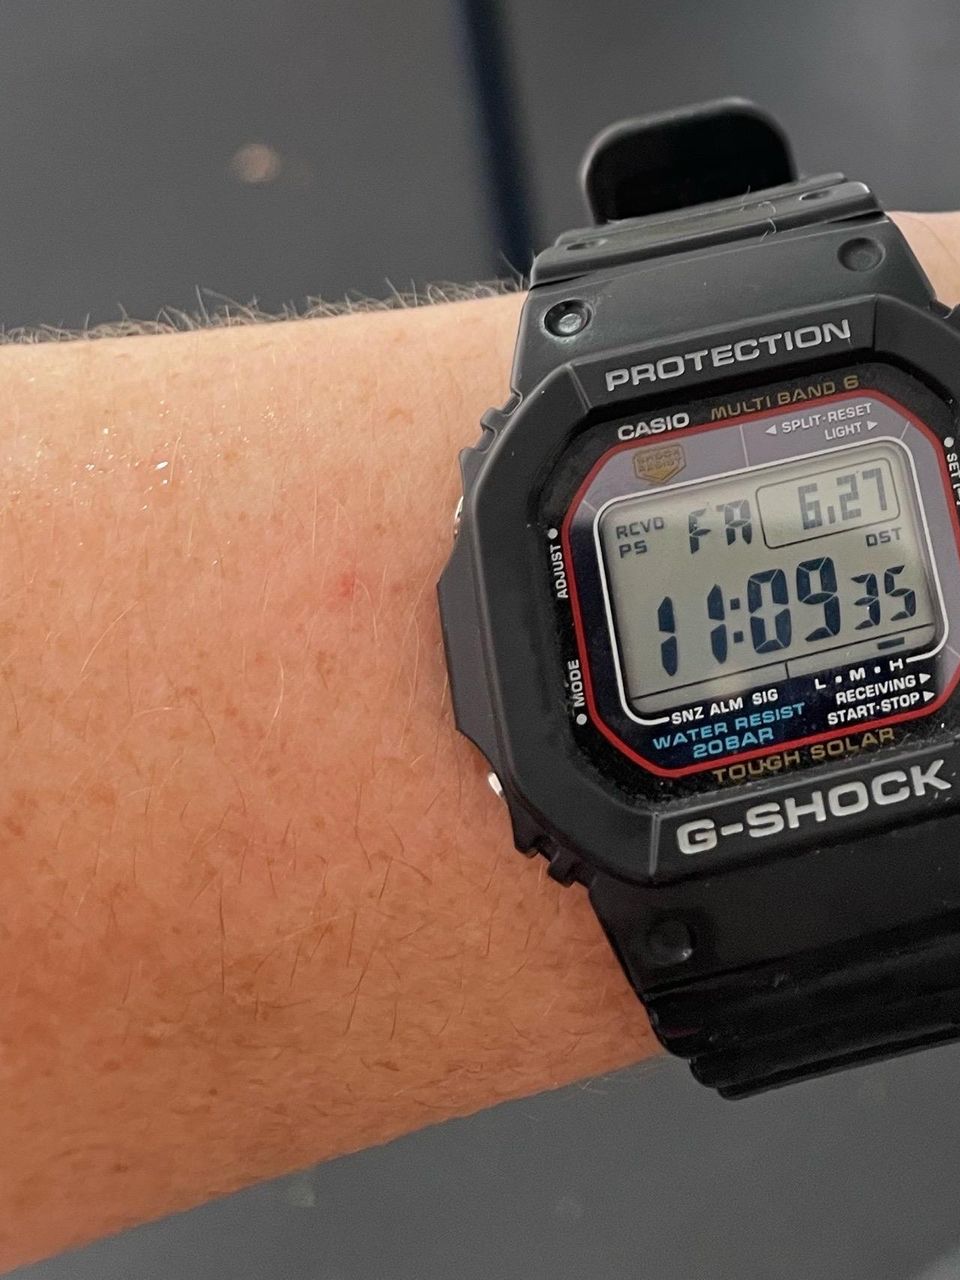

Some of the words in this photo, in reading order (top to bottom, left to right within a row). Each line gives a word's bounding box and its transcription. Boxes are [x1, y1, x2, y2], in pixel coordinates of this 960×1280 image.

[605, 318, 851, 392] PROTECTION
[710, 395, 771, 421] MULTI
[777, 381, 836, 406] BAND
[843, 374, 860, 390] 6
[617, 412, 690, 441] CASIO
[824, 422, 863, 441] LIGHT
[616, 516, 665, 540] RCVD
[865, 527, 902, 548] DST
[619, 540, 648, 559] PS
[549, 544, 569, 599] ADJUST
[567, 658, 585, 708] MODE
[835, 674, 916, 706] RECEIVING
[671, 706, 705, 725] SNZ
[710, 696, 744, 717] ALM
[752, 688, 779, 706] SIG
[652, 721, 728, 750] WATER
[735, 701, 806, 732] RESIST
[693, 727, 774, 759] 20BAR
[712, 750, 801, 783] TOUGH
[810, 727, 896, 761] SOLAR
[676, 759, 952, 855] G-SHOCK
